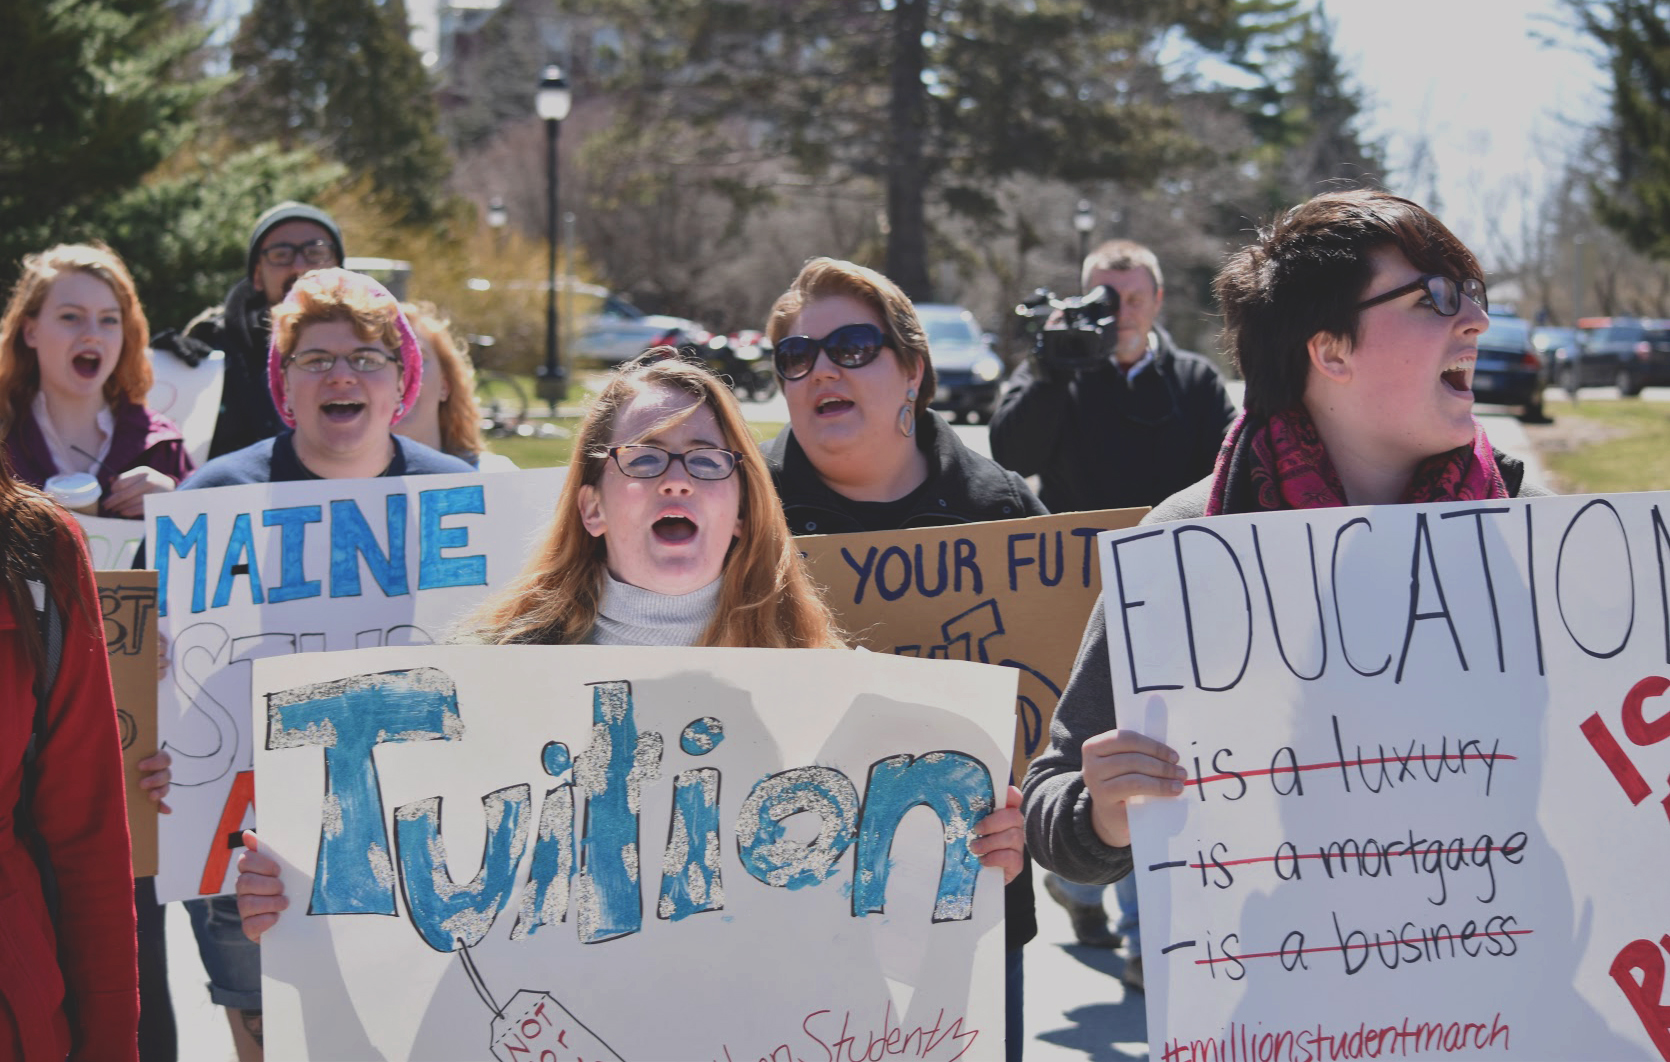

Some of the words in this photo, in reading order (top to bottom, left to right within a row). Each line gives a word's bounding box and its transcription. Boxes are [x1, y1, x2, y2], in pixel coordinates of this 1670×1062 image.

[155, 485, 488, 618] MAINE
[841, 538, 983, 604] YOUR
[1008, 528, 1108, 592] FUT
[1270, 746, 1304, 796] a
[1332, 715, 1499, 797] luxury
[263, 667, 995, 952] Tuition
[1274, 842, 1302, 881] a
[1319, 830, 1529, 906] mortgage
[1279, 930, 1312, 972] a
[1332, 911, 1519, 975] business
